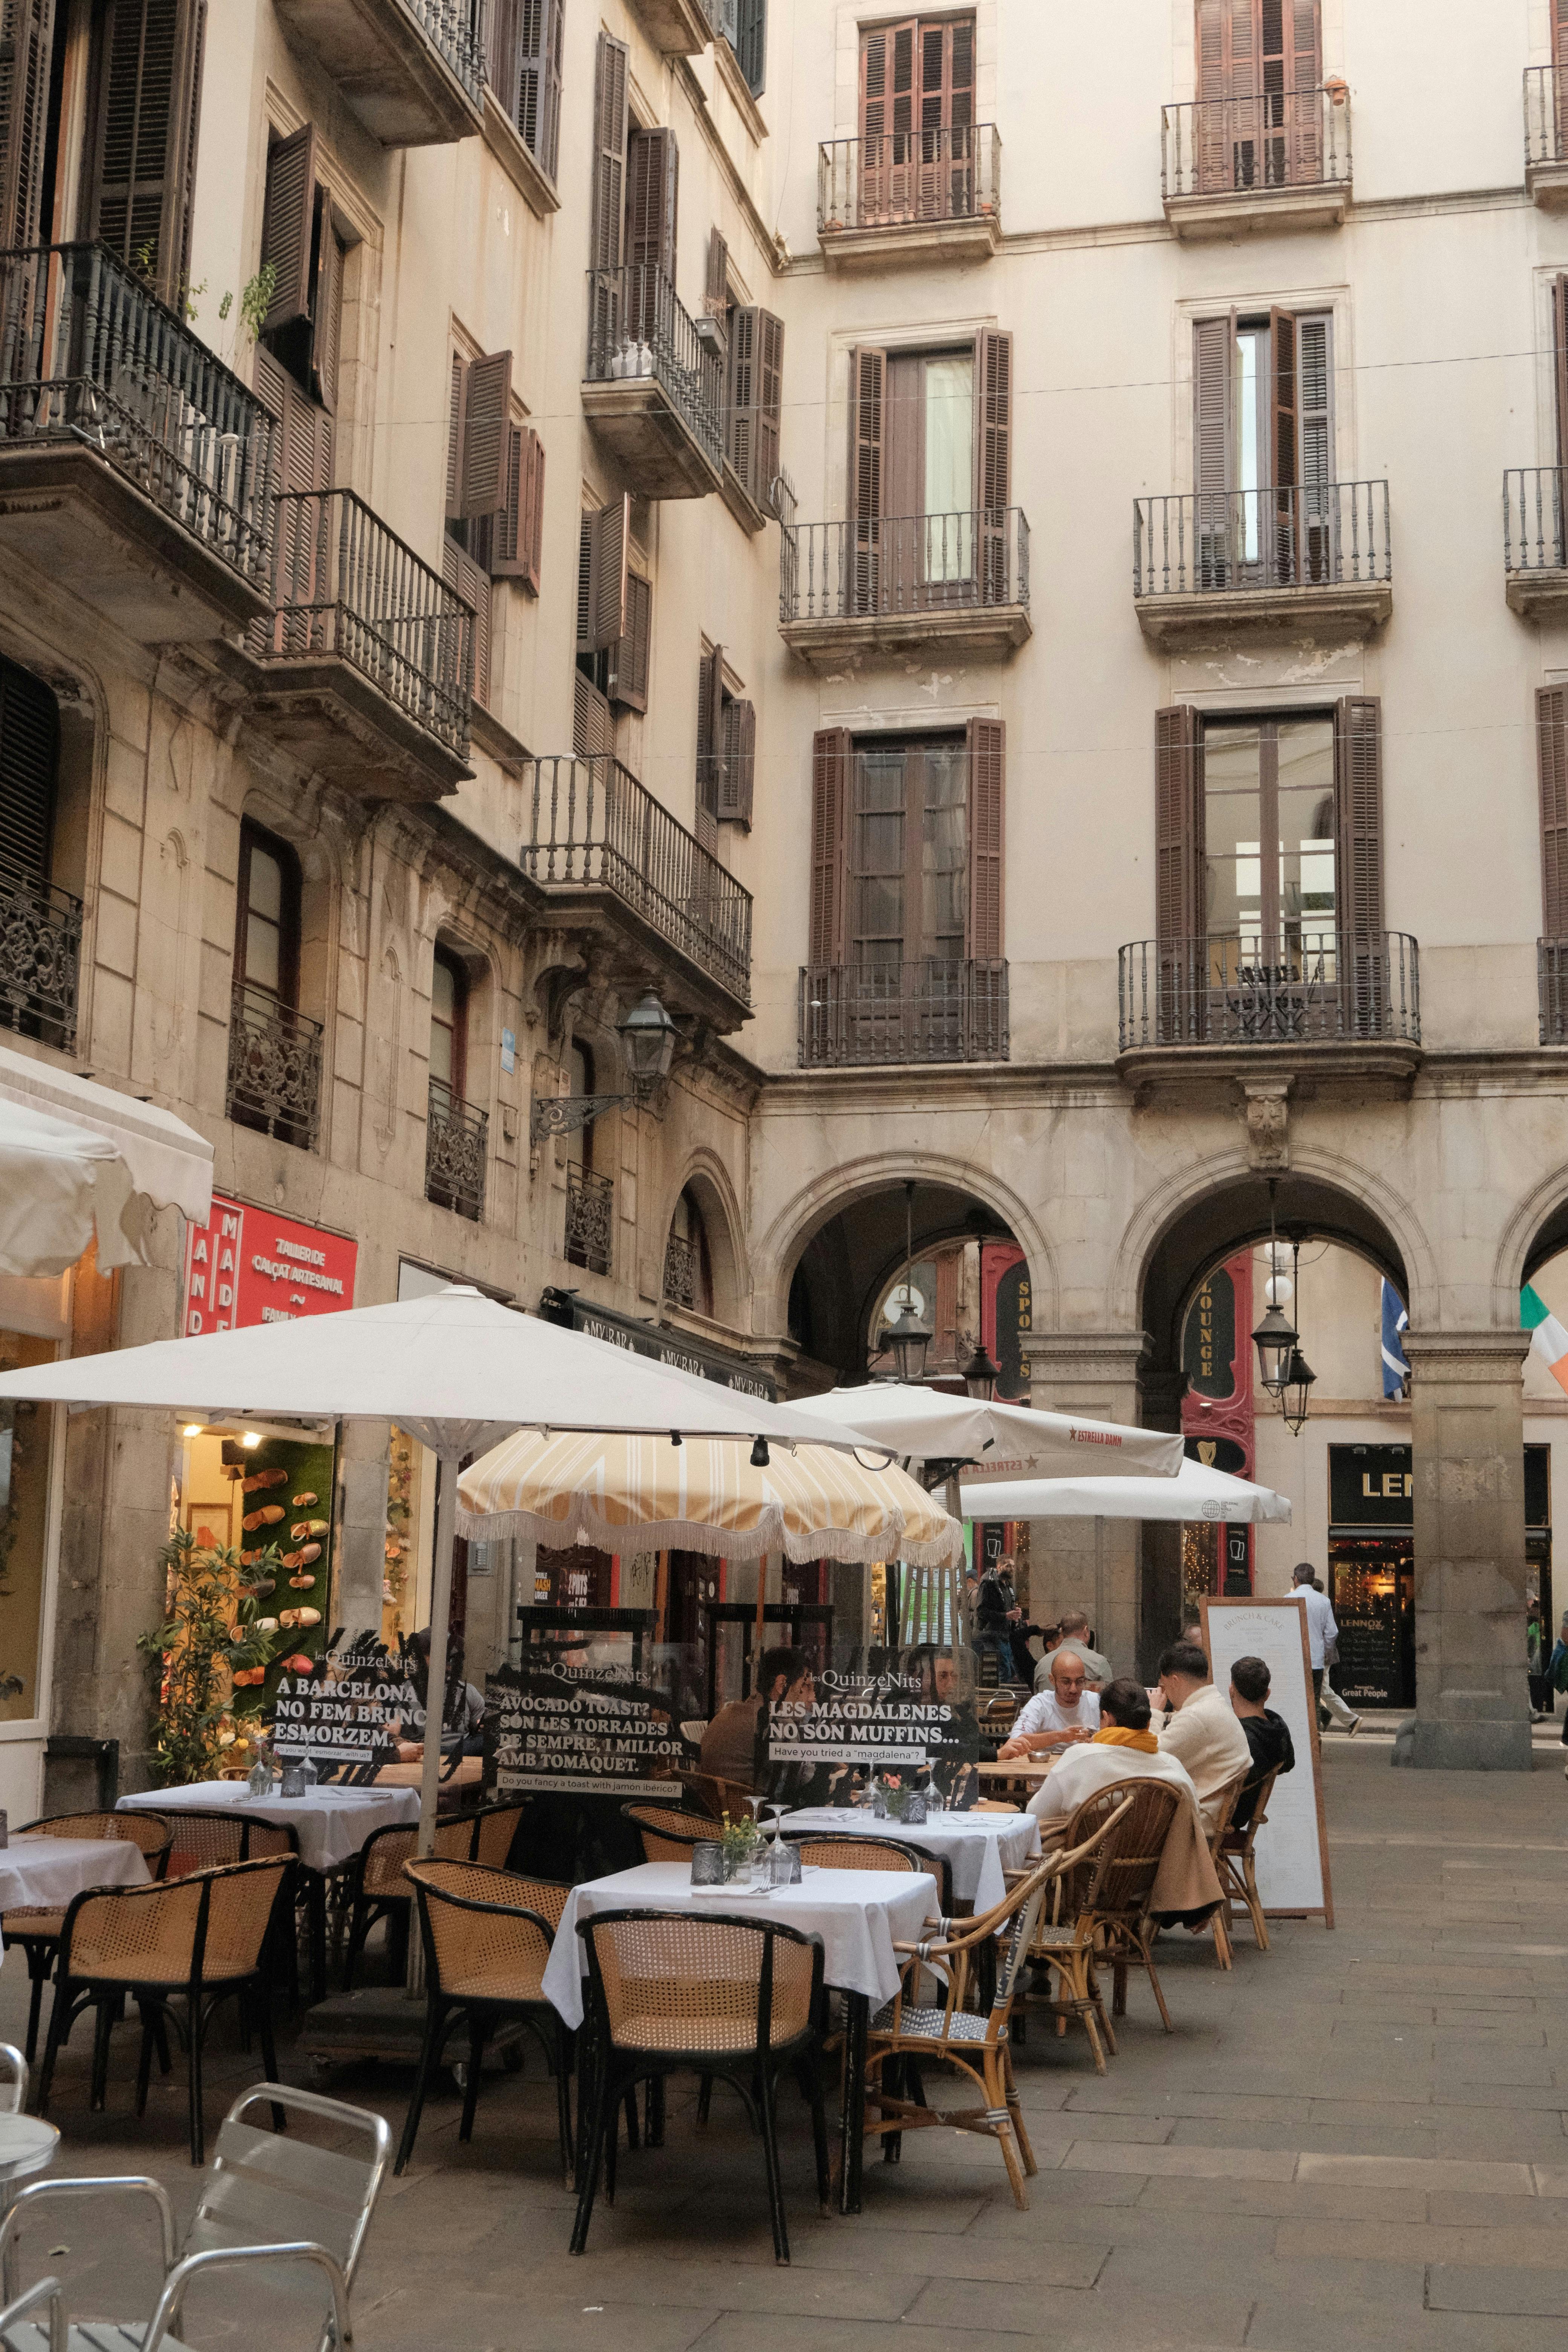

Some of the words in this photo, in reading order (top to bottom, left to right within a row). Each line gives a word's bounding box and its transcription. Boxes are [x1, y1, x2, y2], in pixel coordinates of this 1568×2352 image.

[276, 1238, 311, 1262] TALLER
[311, 1250, 326, 1266] DE
[189, 1225, 209, 1334] AND
[252, 1255, 291, 1282] CALÇAT
[289, 1267, 344, 1295] ARTESANAL
[591, 1321, 605, 1340] MY
[1018, 1282, 1031, 1377] SPOS
[666, 1350, 679, 1367] MY
[1077, 1430, 1104, 1444] ESTRELLA
[1105, 1435, 1122, 1447] DAMM
[534, 1579, 551, 1591] MASH
[534, 1591, 548, 1600] URGER
[276, 1677, 291, 1694] A
[296, 1678, 418, 1703] BARCELONA
[810, 1672, 821, 1682] les
[821, 1670, 922, 1692] QuinzeNits
[1363, 1689, 1388, 1698] People
[276, 1700, 305, 1718] NO
[310, 1702, 352, 1721] FEM
[357, 1705, 448, 1731] BRUNC,
[499, 1696, 582, 1713] AVOCADO
[585, 1699, 650, 1716] TOAST?
[769, 1701, 806, 1717] LES
[812, 1702, 952, 1721] MAGDALENES
[274, 1722, 395, 1747] ESMORZEM.
[499, 1712, 534, 1729] SÓN
[539, 1715, 570, 1731] LES
[574, 1718, 668, 1736] TORRADES
[769, 1723, 799, 1739] NO
[804, 1720, 845, 1741] SÓN
[850, 1725, 960, 1744] MUFFINS...
[499, 1733, 522, 1749] DE
[526, 1734, 601, 1754] SEMPRE,
[605, 1738, 612, 1752] I
[616, 1739, 684, 1756] MILLOR
[775, 1747, 798, 1756] Have
[801, 1749, 818, 1758] you
[821, 1748, 843, 1757] tried
[498, 1752, 537, 1766] AMB
[540, 1751, 640, 1773] TOMÀQUET.
[517, 1778, 532, 1787] you
[534, 1778, 558, 1788] fancy
[568, 1780, 590, 1788] toast
[592, 1781, 611, 1790] with
[613, 1782, 640, 1792] jamón
[643, 1783, 677, 1793] ibérico?
